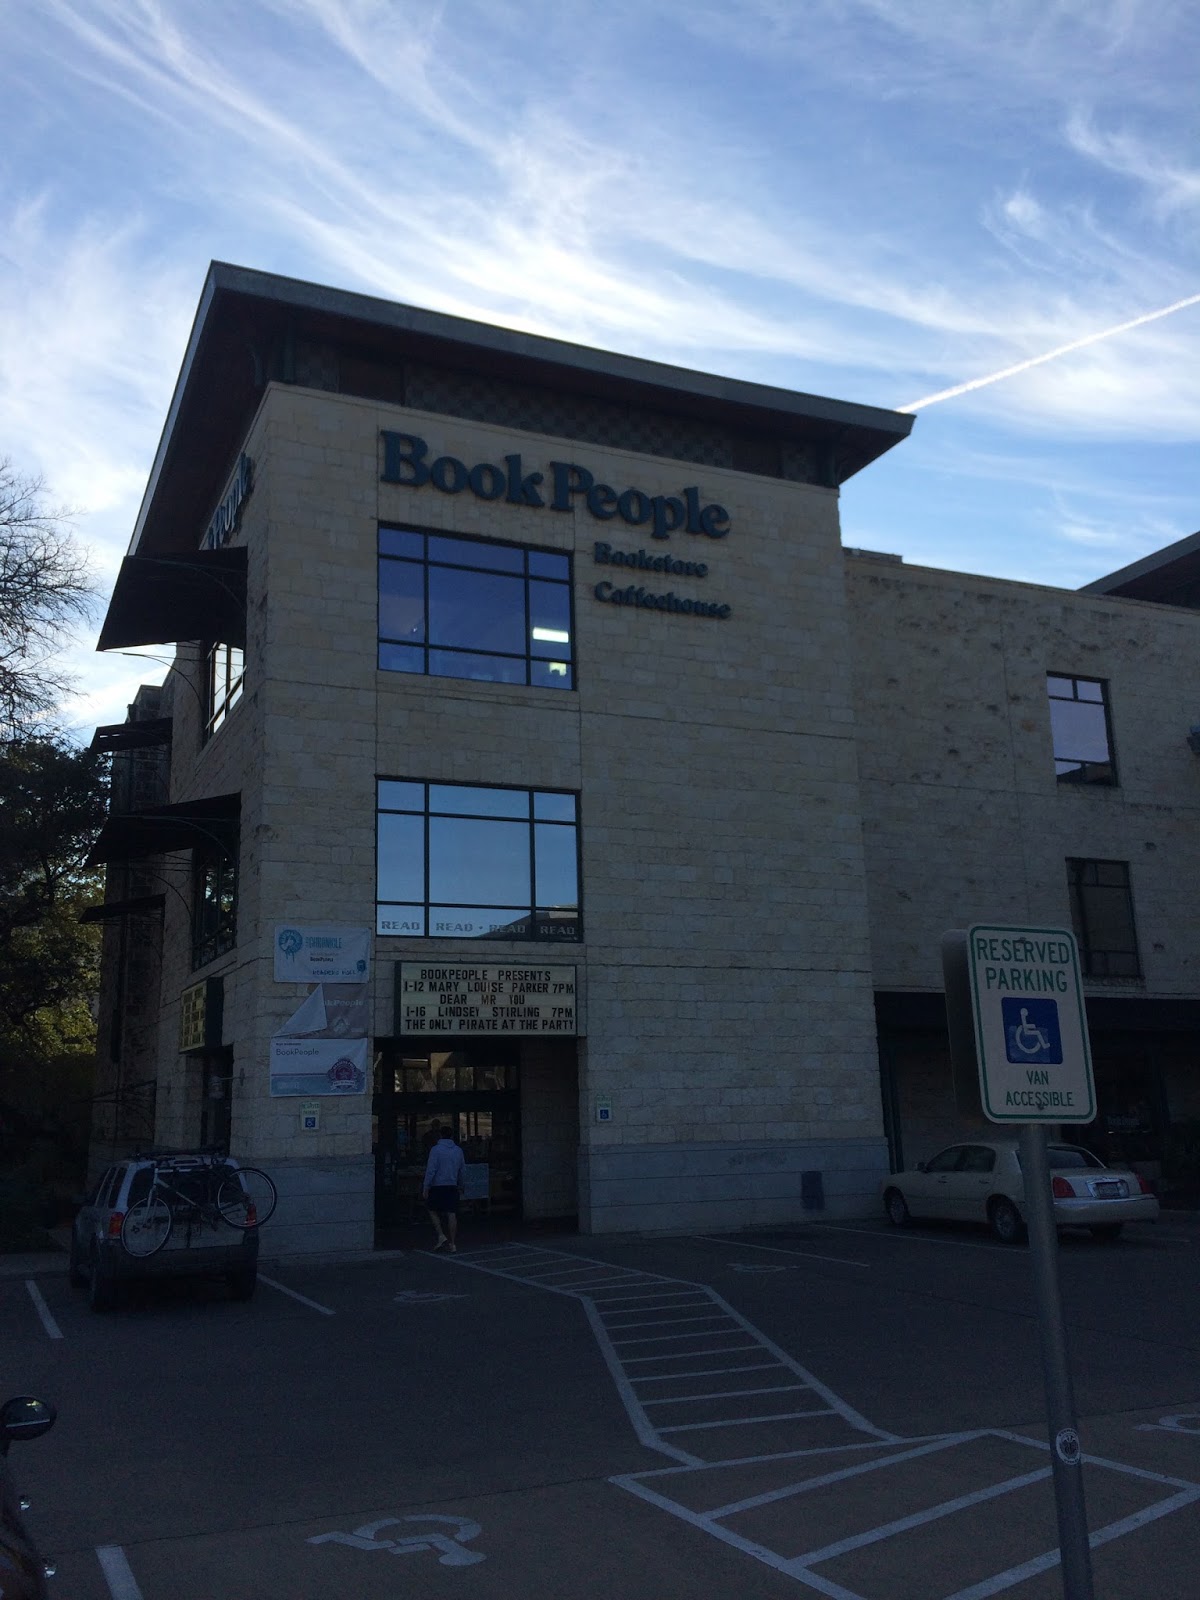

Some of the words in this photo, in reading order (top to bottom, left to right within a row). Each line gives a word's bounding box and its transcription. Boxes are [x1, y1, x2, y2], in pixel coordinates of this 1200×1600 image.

[594, 541, 709, 578] Bookstore
[594, 581, 732, 619] Coffeehouse
[381, 920, 420, 931] READ
[435, 921, 473, 932] READ
[489, 923, 526, 934] READ
[539, 925, 575, 936] READ
[976, 937, 1070, 964] RESERVED
[420, 969, 488, 981] BOOKPEOPLE
[498, 970, 551, 981] PRESENTS
[985, 967, 1068, 993] PARKING
[404, 981, 424, 993] 1-12
[429, 981, 459, 993] MARY
[467, 982, 504, 993] LOUISE
[512, 982, 549, 994] PARKER
[553, 983, 574, 994] 7PM
[440, 994, 467, 1005] DEAR
[481, 994, 496, 1005] MR
[509, 994, 525, 1005] YOU
[406, 1006, 426, 1017] 1-16
[438, 1006, 480, 1017] LINDSEY
[492, 1007, 540, 1018] STIRLING
[552, 1007, 573, 1018] 7PM
[406, 1019, 425, 1030] THE
[429, 1019, 453, 1030] ONLY
[459, 1019, 498, 1030] PIRATE
[502, 1019, 515, 1030] AT
[519, 1019, 538, 1030] THE
[542, 1019, 574, 1030] PARTY
[1026, 1070, 1049, 1085] VAN
[1005, 1091, 1075, 1107] ACCESSIBLE
